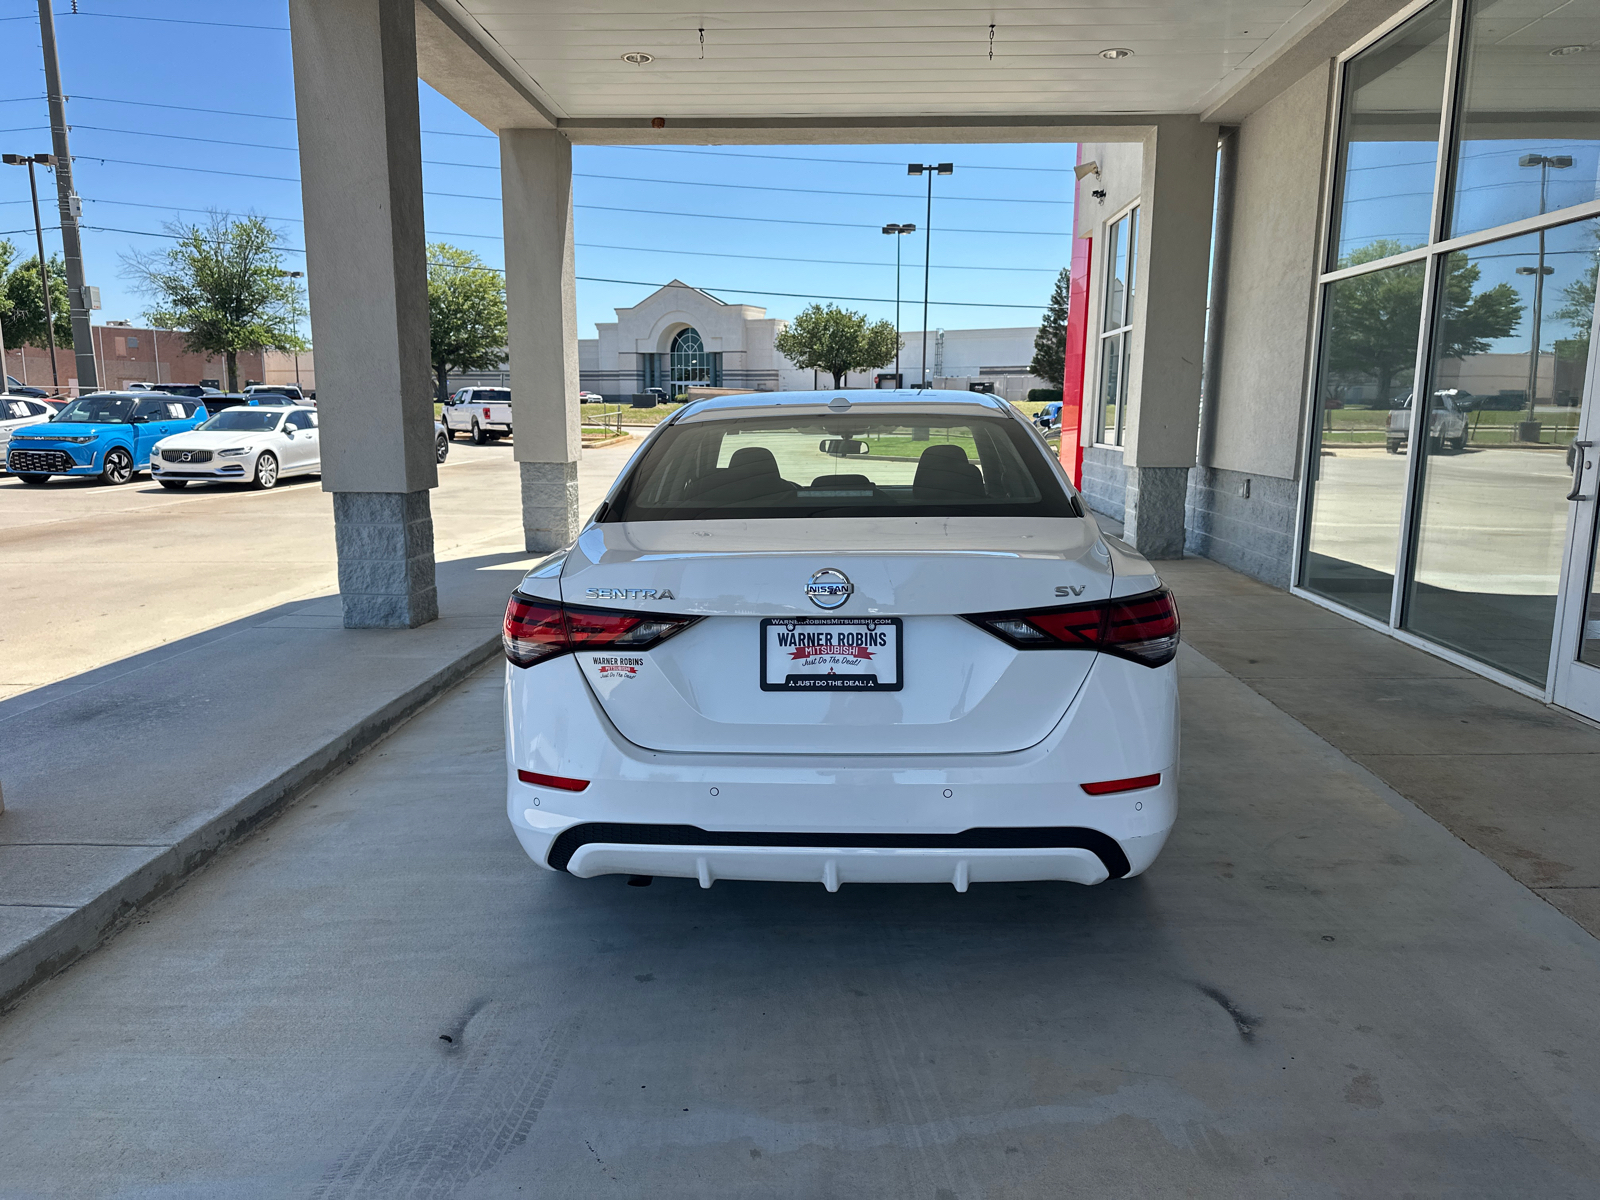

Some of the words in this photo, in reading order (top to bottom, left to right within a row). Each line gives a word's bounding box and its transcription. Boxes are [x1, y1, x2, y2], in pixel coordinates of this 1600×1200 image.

[585, 587, 676, 600] SENTRA
[809, 585, 849, 593] NISSAN
[1054, 584, 1086, 597] SV
[777, 632, 833, 647] WARNER
[838, 632, 887, 647] ROBINS
[805, 646, 858, 656] MITSUBISHI
[592, 656, 619, 666] WARNER
[620, 657, 644, 666] ROBINS
[802, 657, 817, 666] Just
[818, 656, 827, 664] Do
[828, 656, 840, 664] The
[841, 657, 861, 666] Deal!
